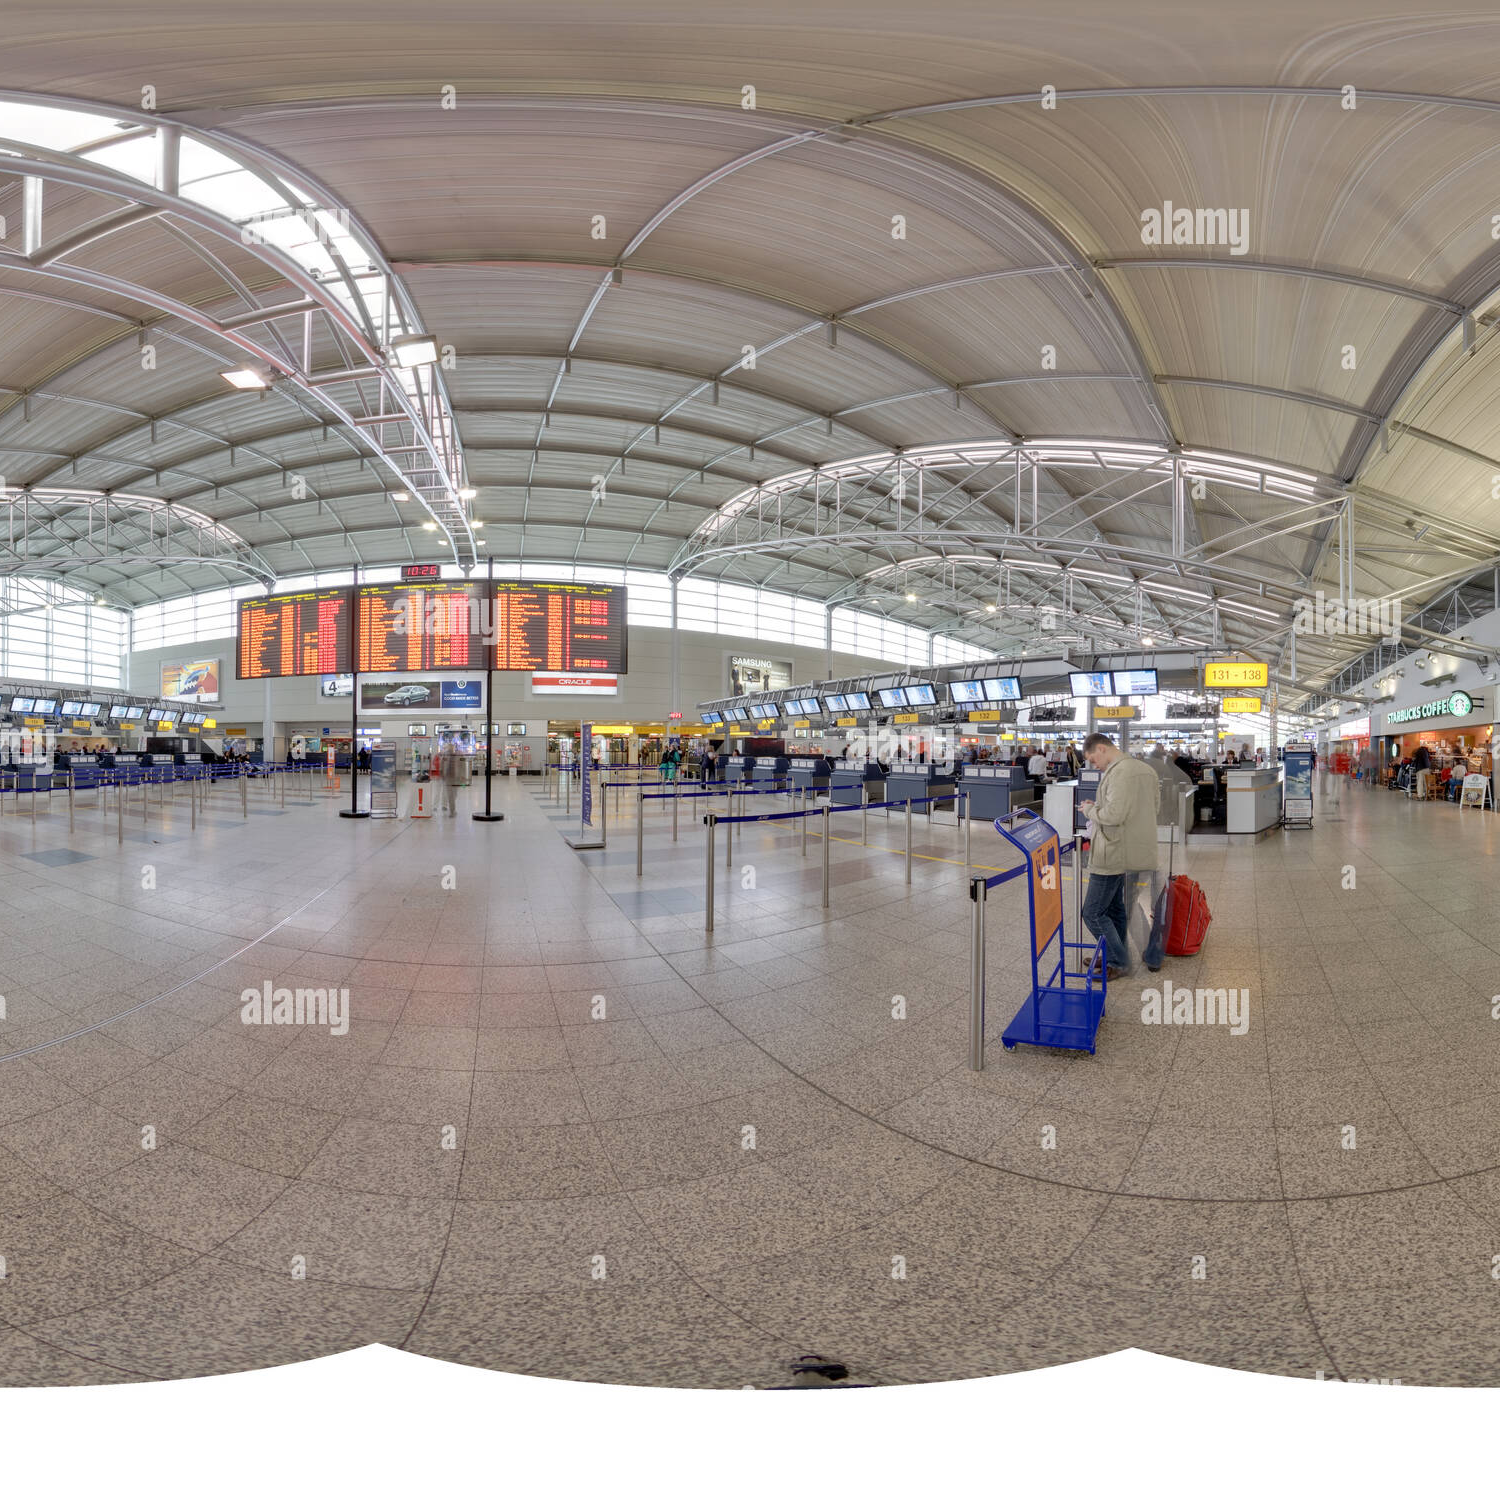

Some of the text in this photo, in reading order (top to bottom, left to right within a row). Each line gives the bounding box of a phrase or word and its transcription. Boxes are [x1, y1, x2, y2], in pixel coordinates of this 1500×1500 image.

[407, 566, 437, 576] 10:26
[732, 656, 772, 668] SAMSUNG
[1212, 670, 1230, 680] 131
[1242, 670, 1261, 680] 138
[328, 682, 338, 692] 4
[1387, 705, 1421, 724] STARBUCKS
